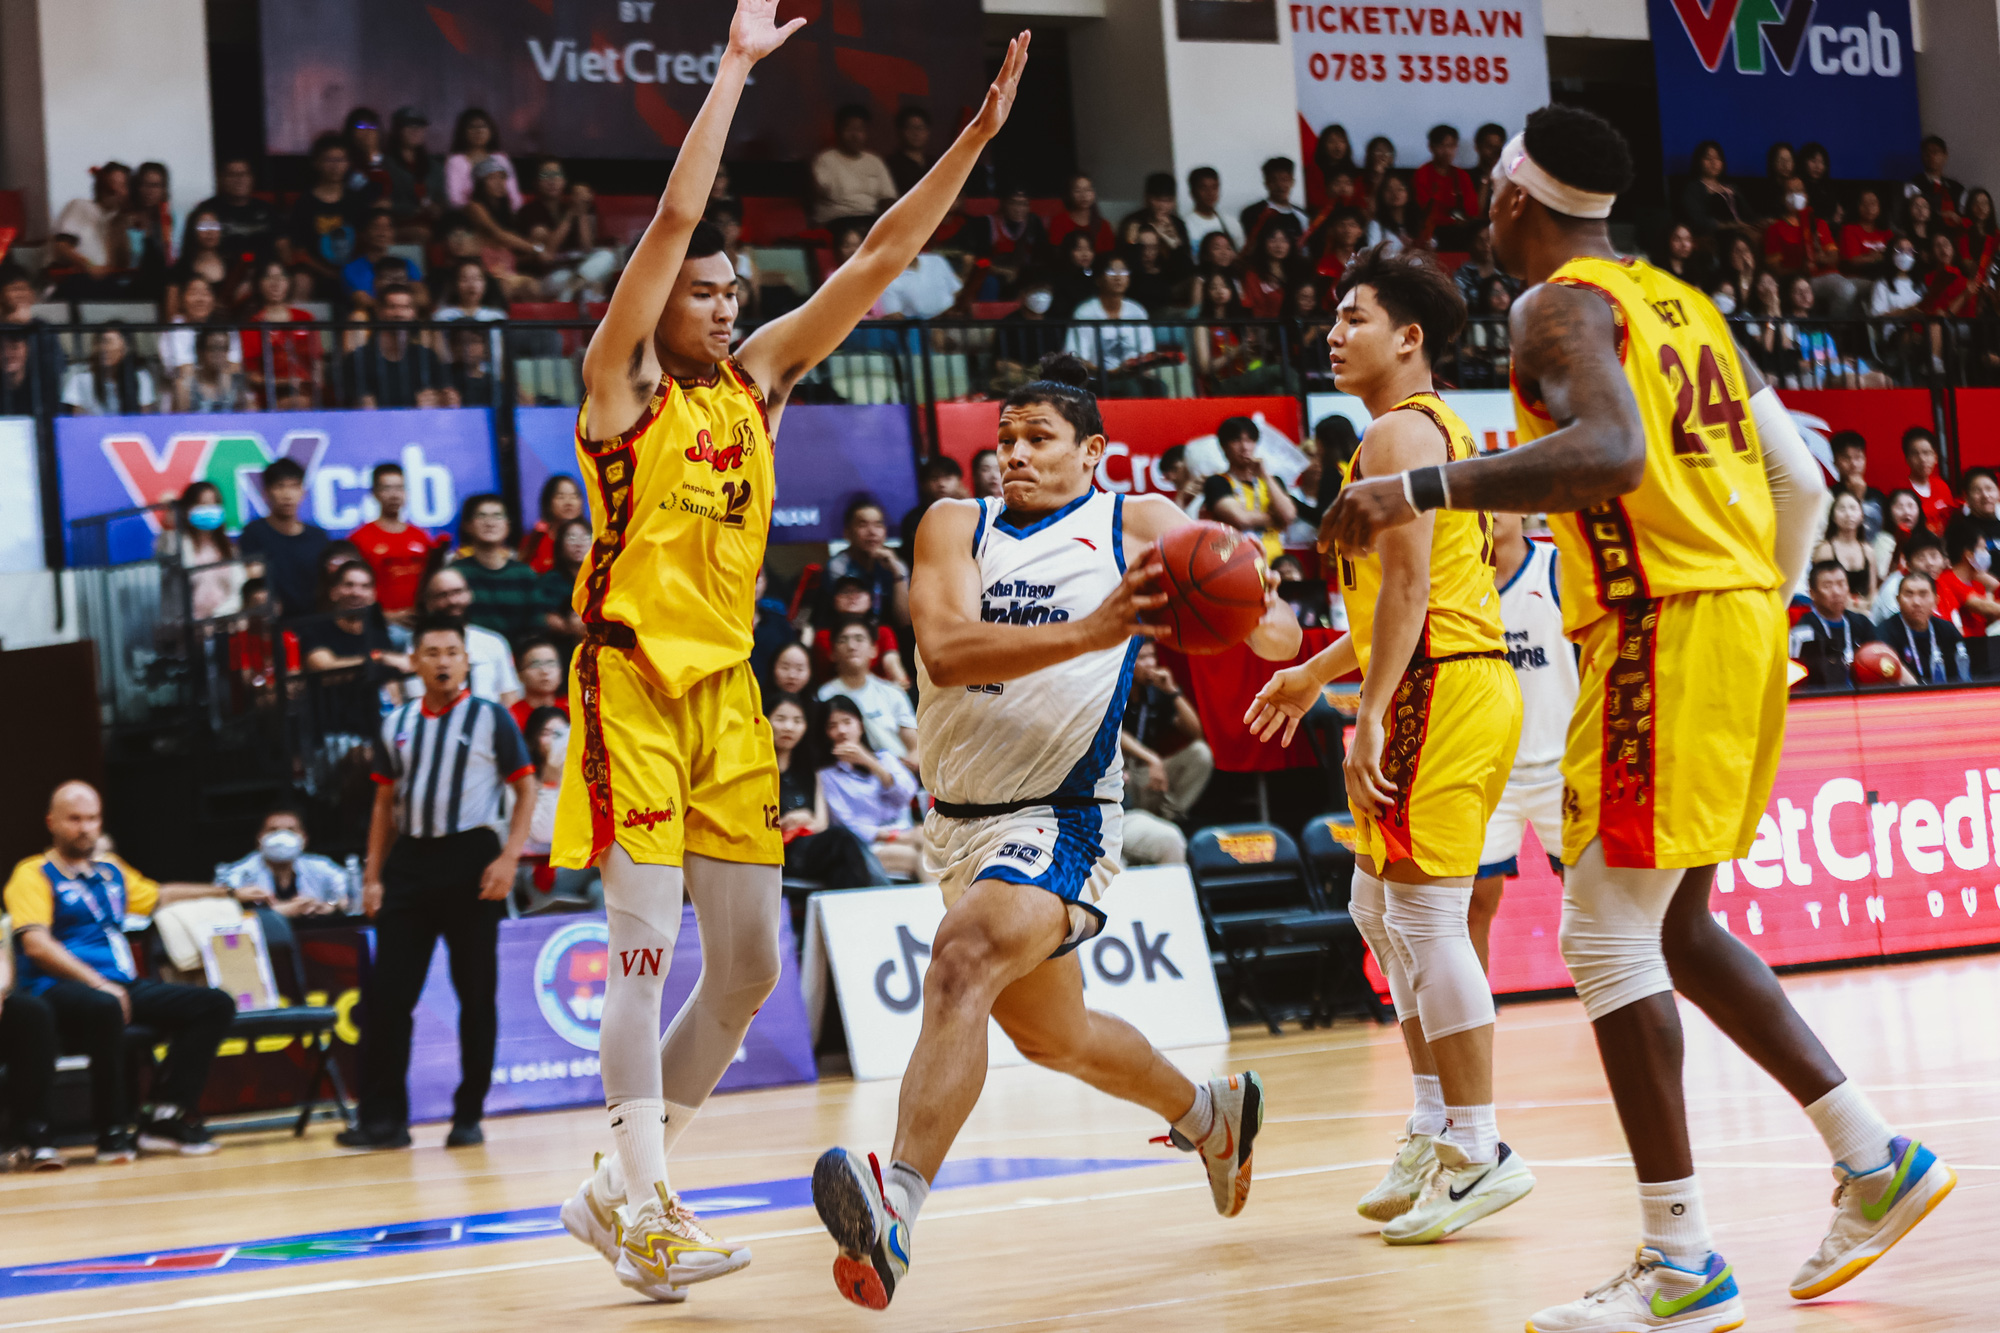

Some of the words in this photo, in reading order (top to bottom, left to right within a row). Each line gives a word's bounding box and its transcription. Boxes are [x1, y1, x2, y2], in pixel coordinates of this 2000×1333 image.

[618, 1, 656, 23] BY
[1289, 5, 1524, 38] TICKET.VBA.VN
[526, 38, 755, 85] VietCred
[1308, 53, 1388, 82] 0783
[1397, 55, 1510, 84] 335885
[1659, 344, 1746, 456] 24
[623, 807, 672, 832] Saigon
[620, 948, 664, 978] VN
